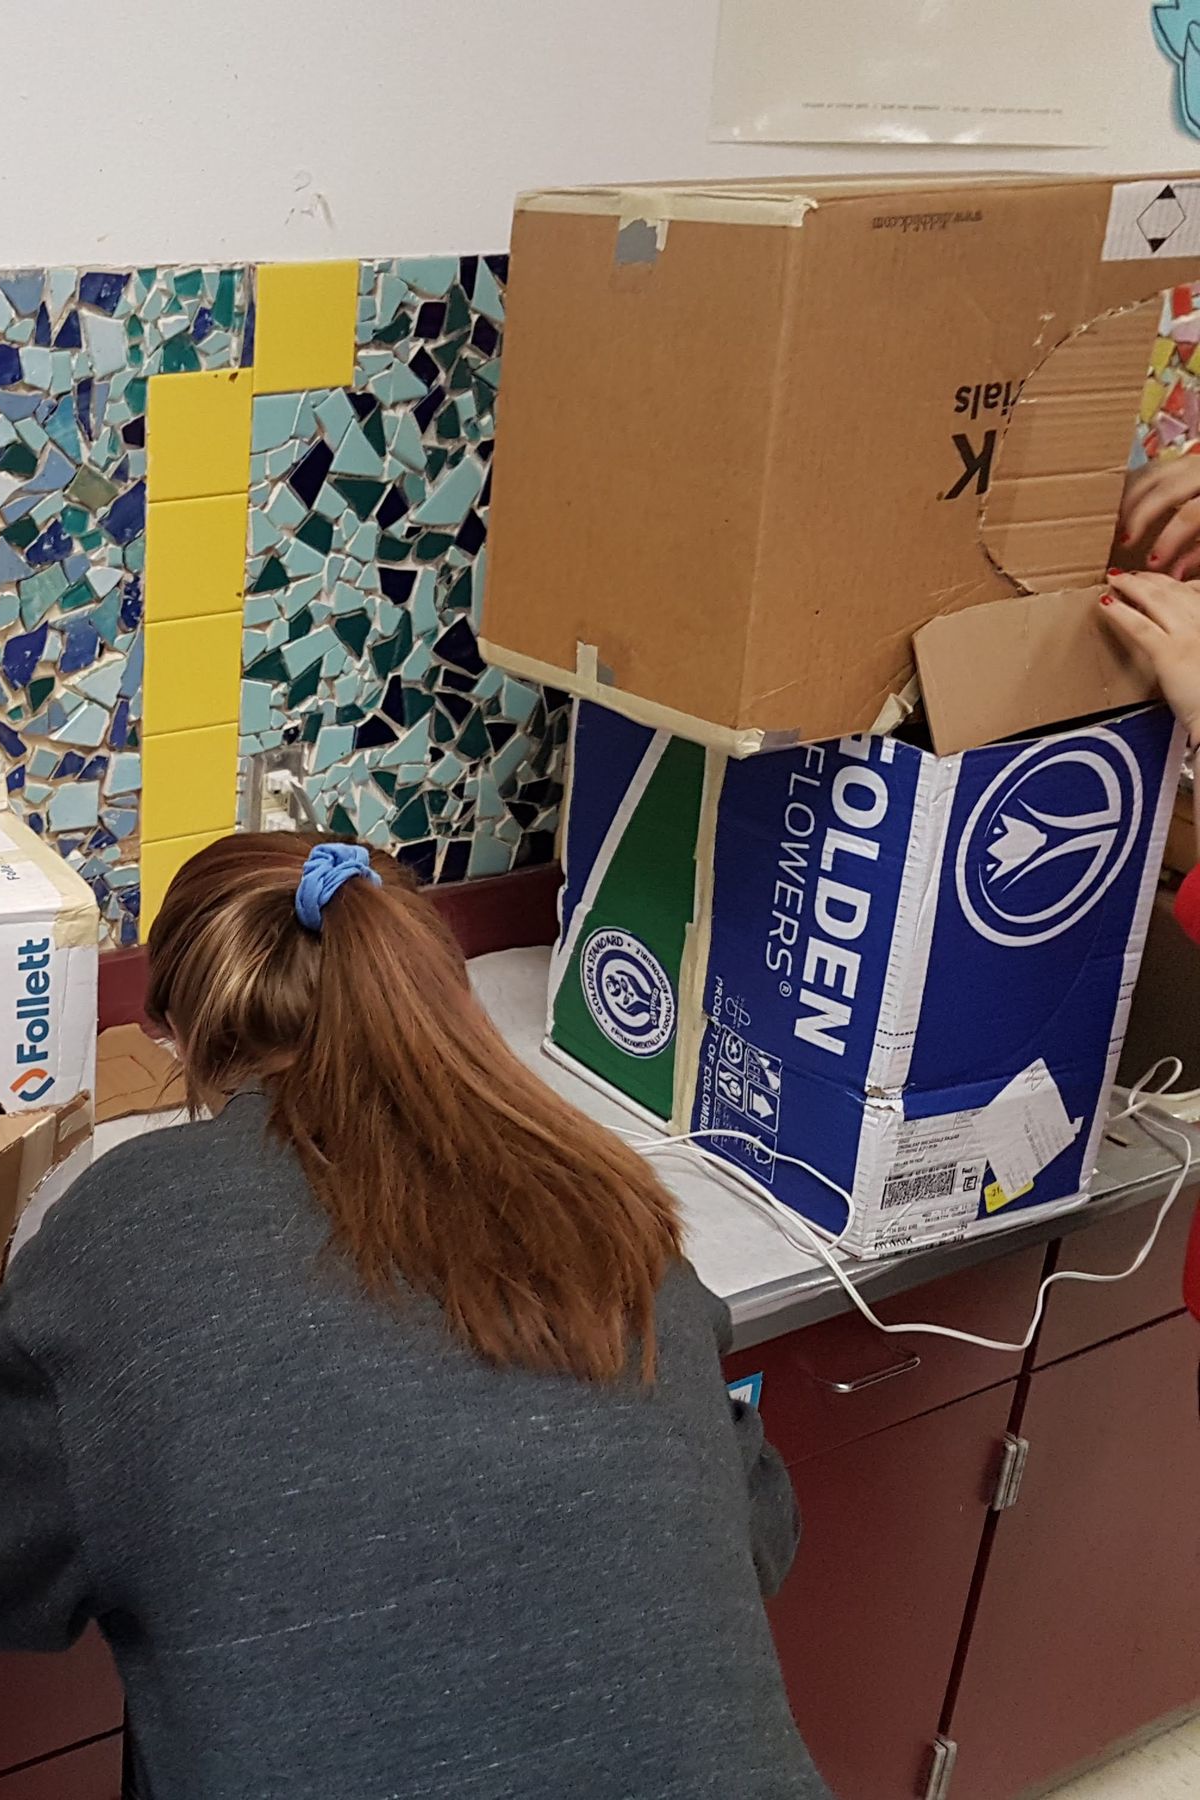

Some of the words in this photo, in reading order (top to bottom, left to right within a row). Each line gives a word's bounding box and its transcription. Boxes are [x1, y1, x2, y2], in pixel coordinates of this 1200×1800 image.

[587, 934, 625, 965] STANDARD
[16, 937, 51, 1065] Follett
[585, 966, 604, 1016] GOLDEN
